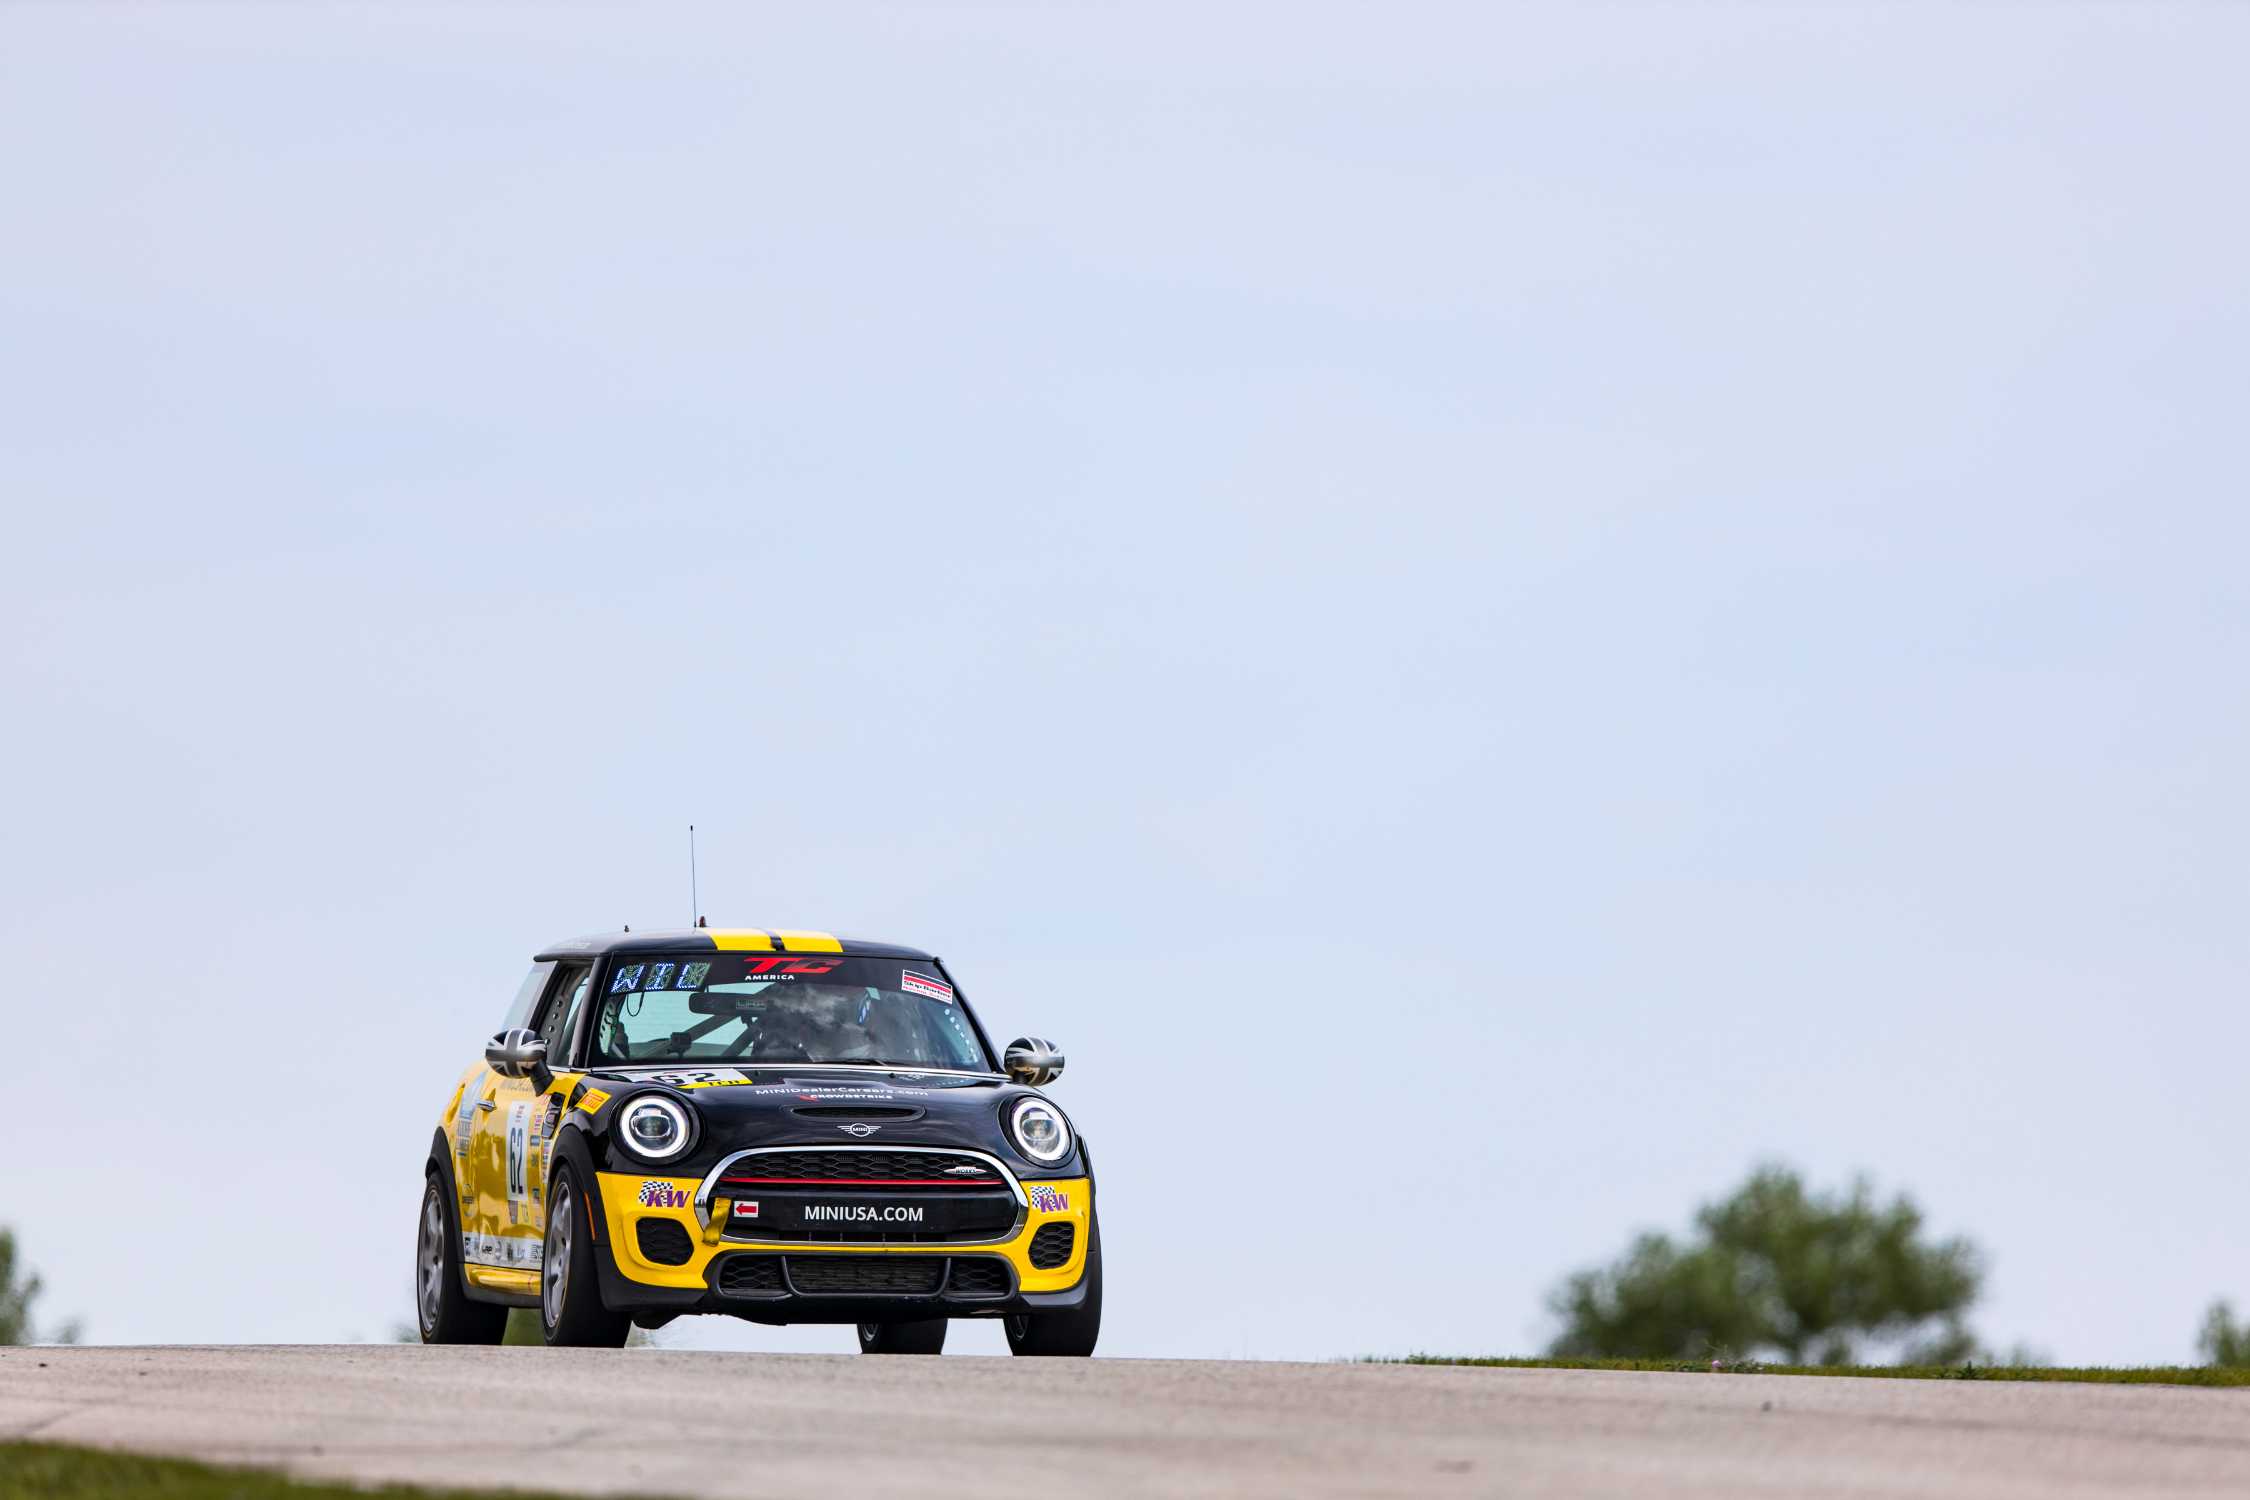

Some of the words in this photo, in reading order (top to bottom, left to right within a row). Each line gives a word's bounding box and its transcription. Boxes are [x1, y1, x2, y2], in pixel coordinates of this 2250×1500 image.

[755, 1087, 929, 1096] MINIDealerCareers.com
[510, 1127, 523, 1195] 62
[646, 1190, 690, 1208] KW
[1039, 1193, 1069, 1213] KW
[804, 1206, 924, 1222] MINIUSA.COM
